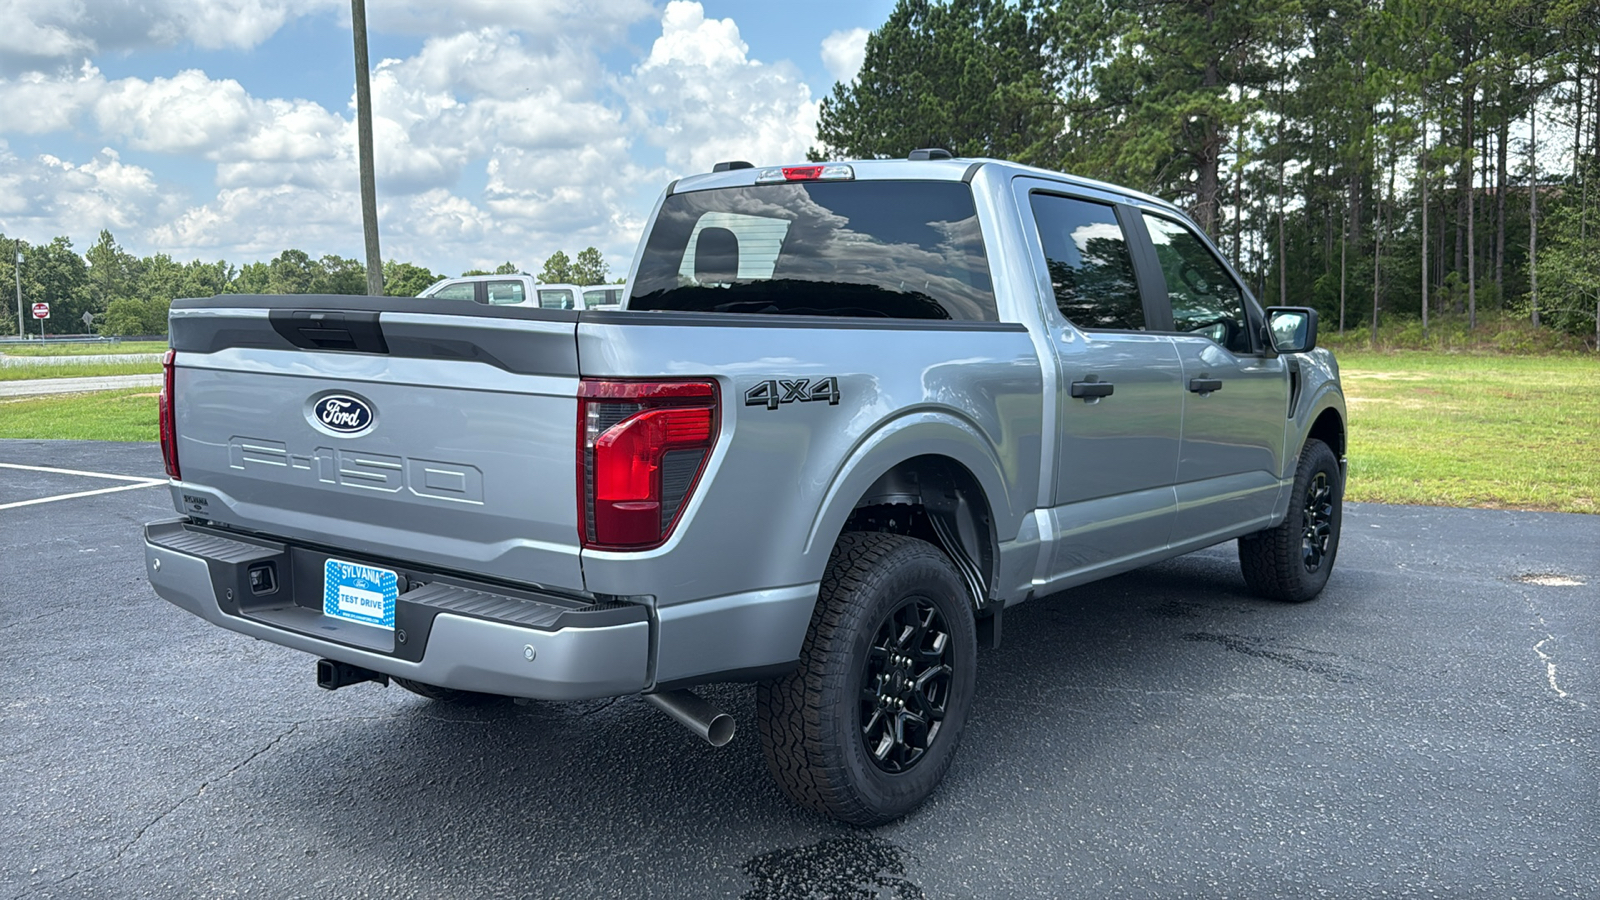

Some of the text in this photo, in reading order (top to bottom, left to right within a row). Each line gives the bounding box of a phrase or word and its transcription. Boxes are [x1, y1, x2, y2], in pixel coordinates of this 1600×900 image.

[323, 400, 360, 426] Ford
[228, 435, 484, 505] F-150
[342, 565, 380, 587] SYLVANIA
[341, 594, 382, 610] TEST DRIVE
